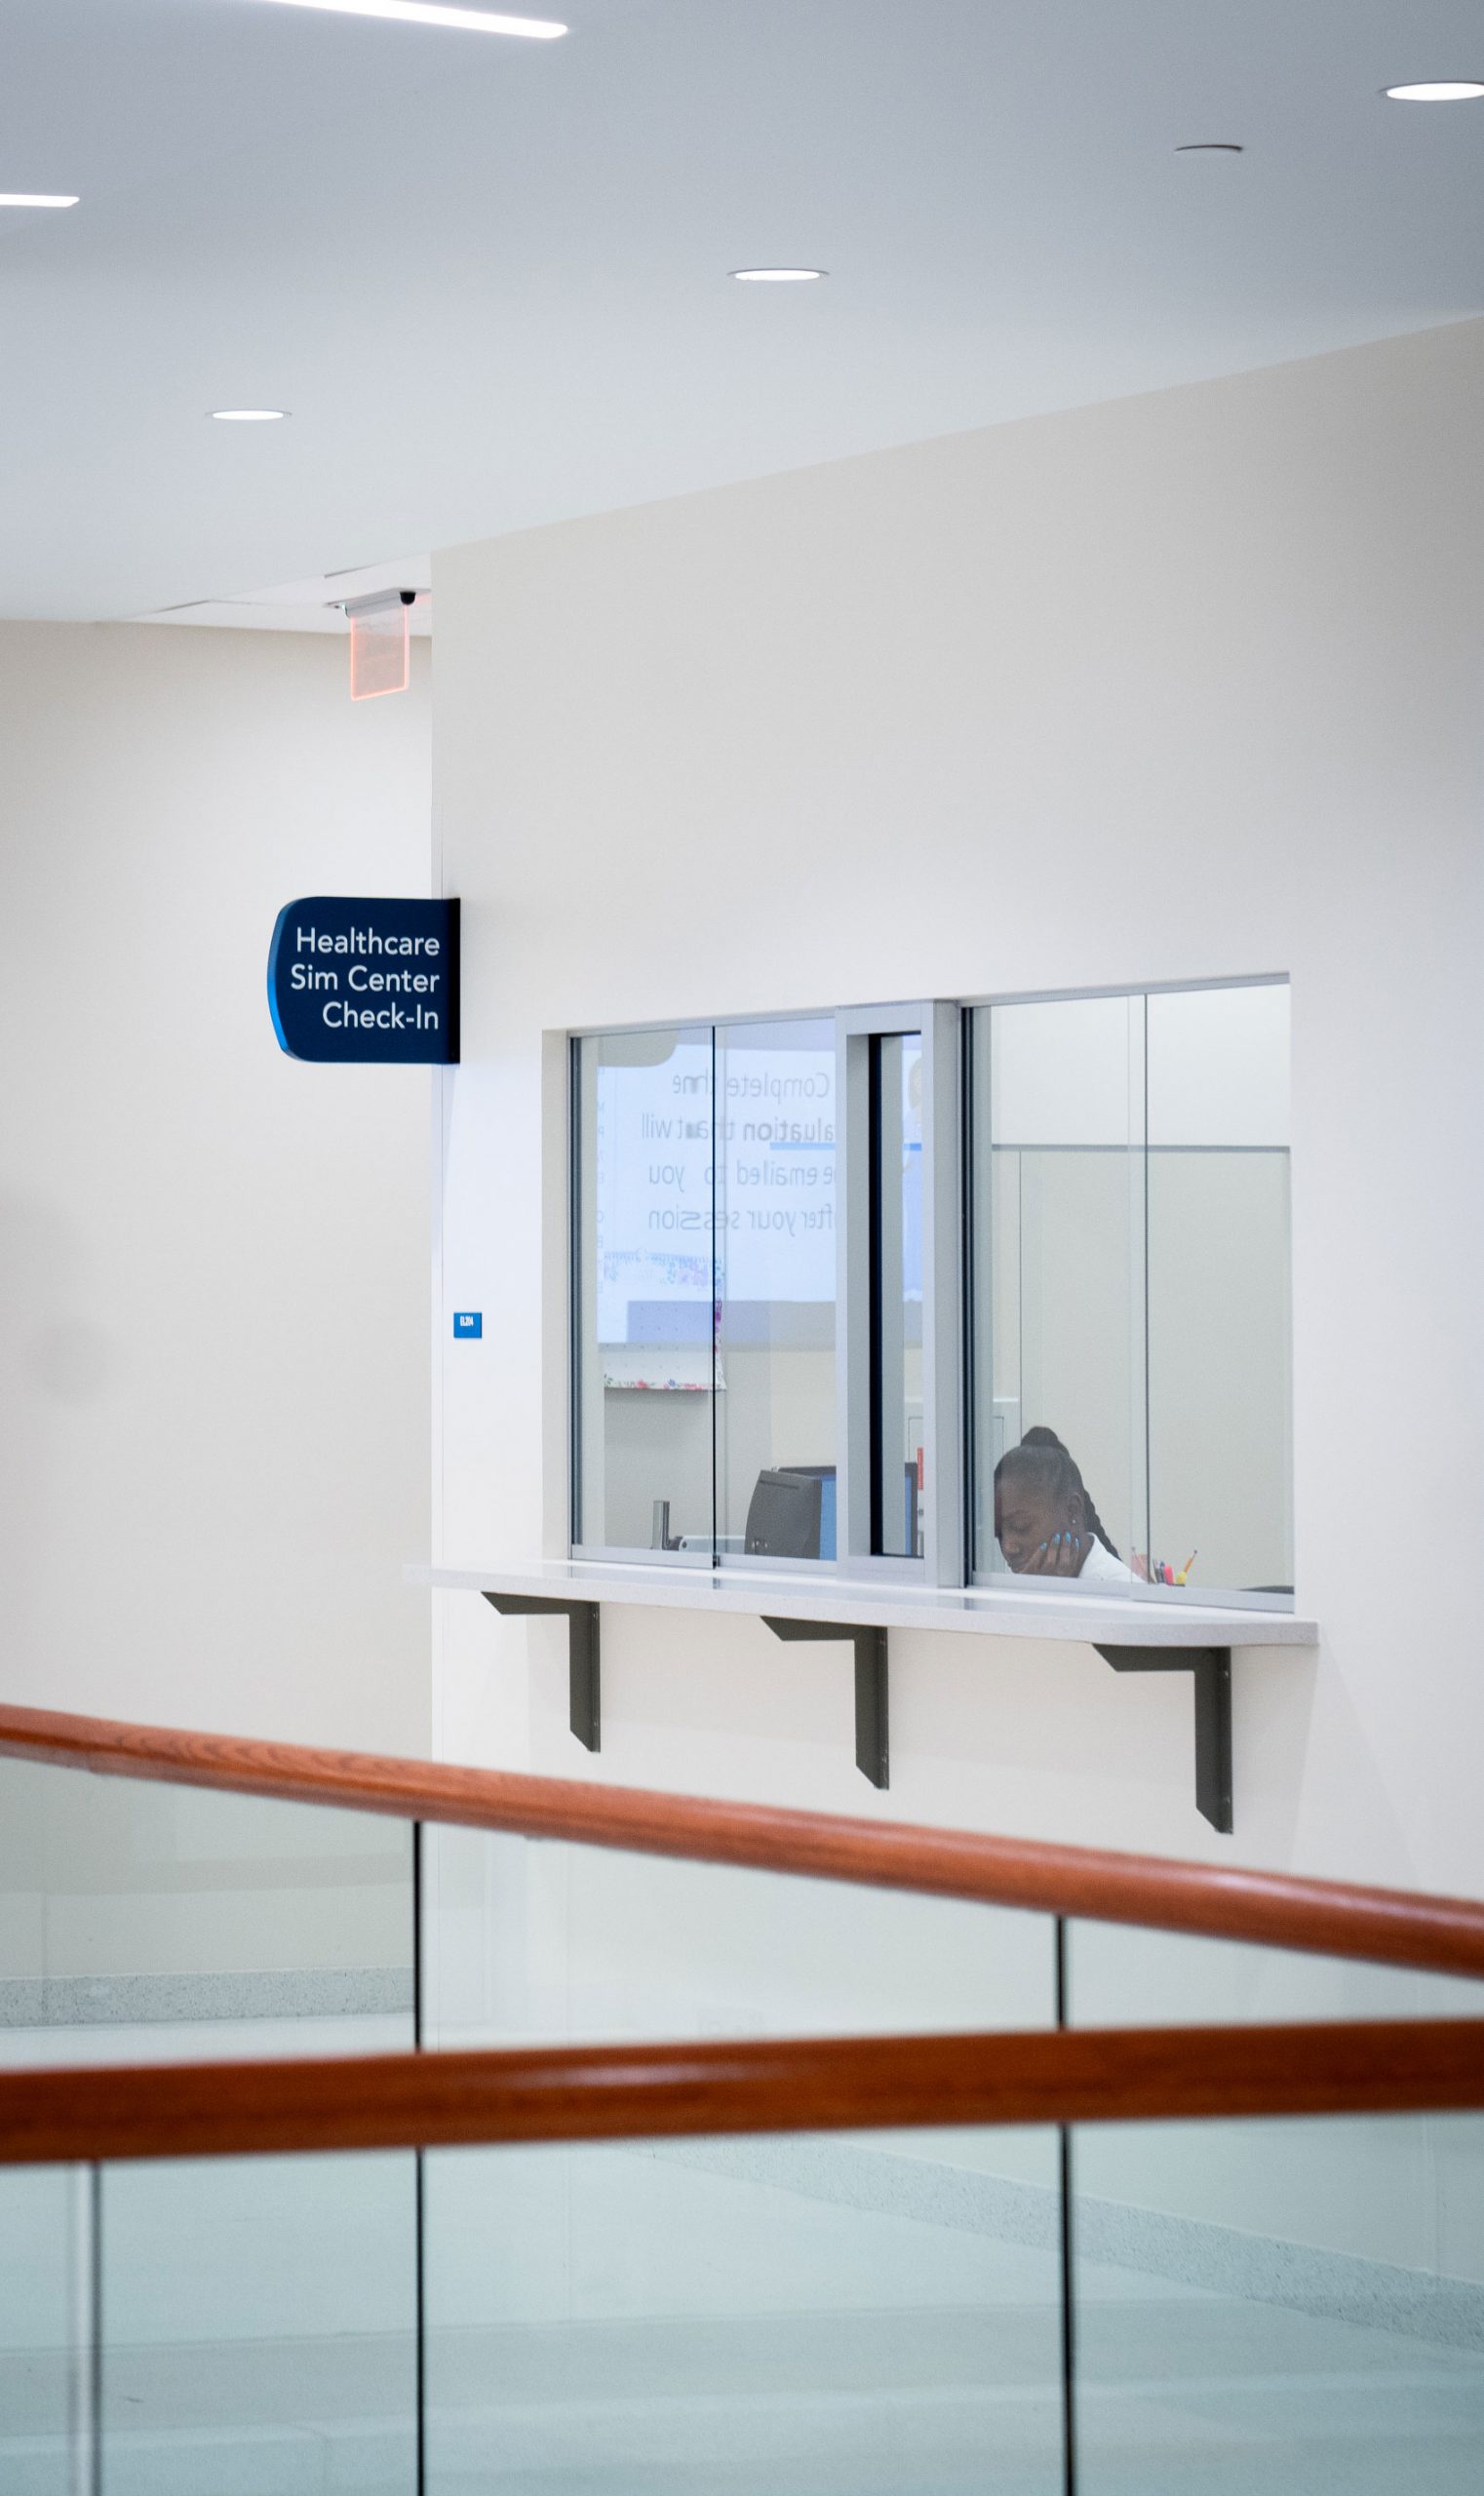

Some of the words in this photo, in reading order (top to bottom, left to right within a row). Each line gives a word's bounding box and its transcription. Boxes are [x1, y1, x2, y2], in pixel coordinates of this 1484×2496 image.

[296, 926, 440, 956] Healthcare
[291, 963, 338, 991] Sim
[347, 964, 441, 994] Center
[322, 1000, 440, 1031] Check-In
